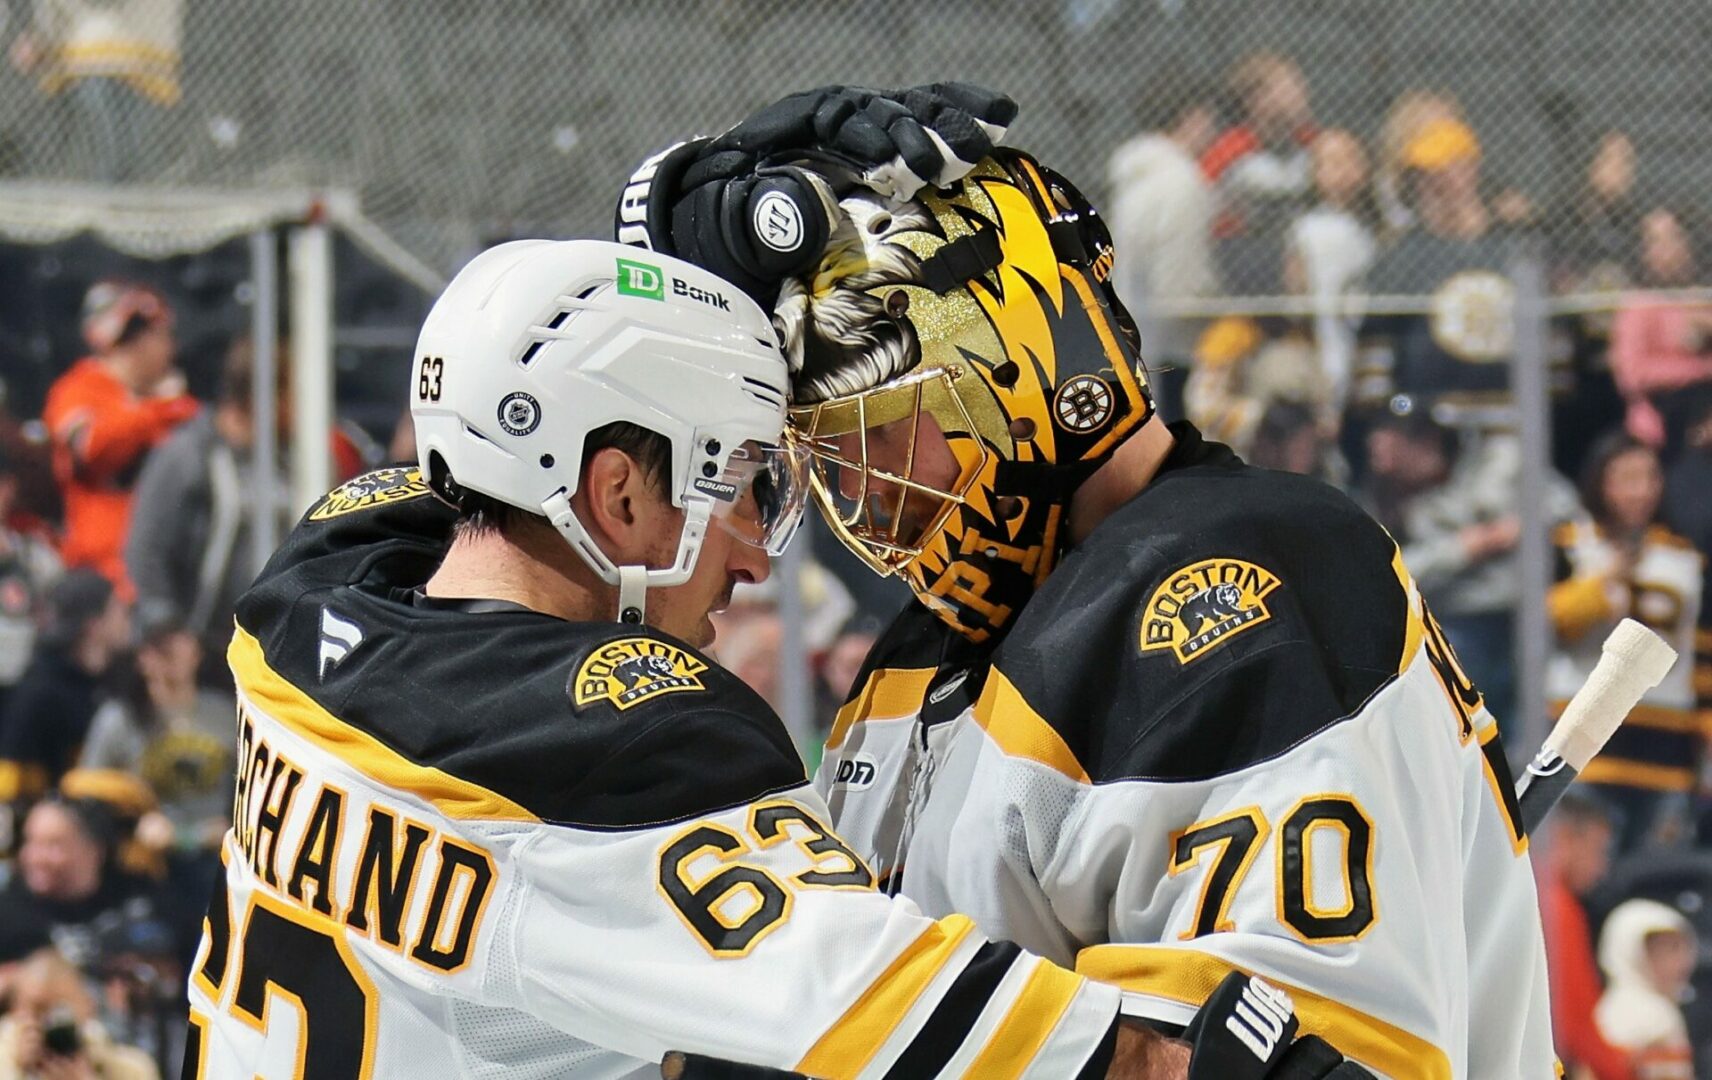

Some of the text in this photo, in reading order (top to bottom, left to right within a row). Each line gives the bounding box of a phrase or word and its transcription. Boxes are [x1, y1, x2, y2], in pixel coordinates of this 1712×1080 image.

[618, 262, 731, 312] TD Bank
[418, 356, 444, 403] 63
[513, 393, 535, 403] UNITY
[500, 418, 532, 436] EQUALITY
[313, 482, 428, 516] OSTON
[695, 480, 735, 493] BAUER
[1146, 562, 1276, 645] BOSTON
[1190, 610, 1254, 651] BRUINS
[581, 640, 702, 700] BOSTON
[235, 703, 499, 976] RCHAND
[656, 799, 878, 960] 63
[1166, 792, 1380, 945] 70
